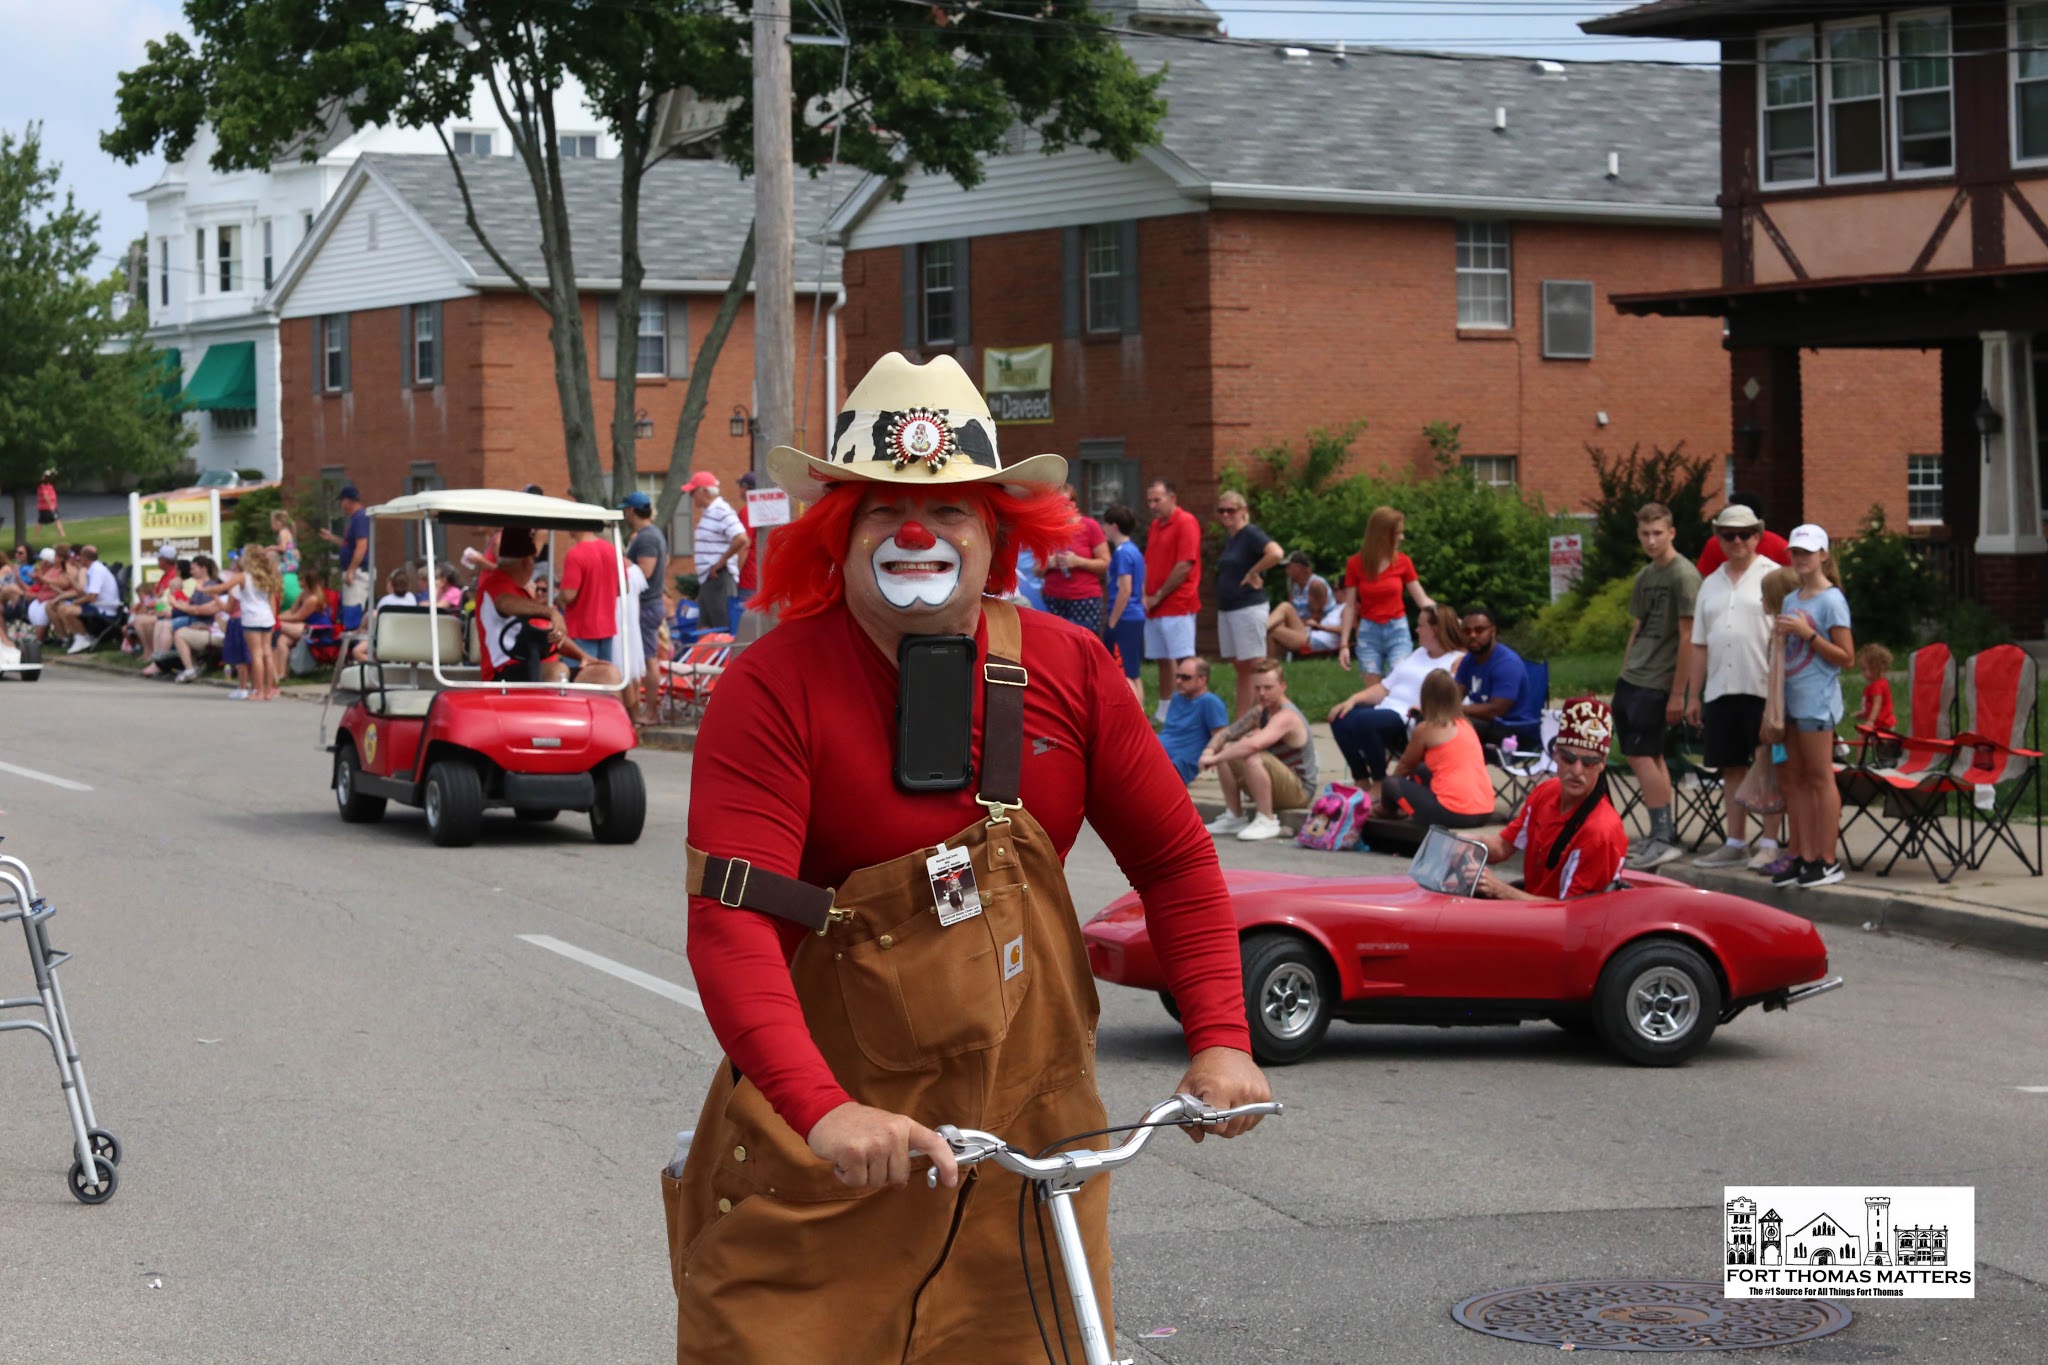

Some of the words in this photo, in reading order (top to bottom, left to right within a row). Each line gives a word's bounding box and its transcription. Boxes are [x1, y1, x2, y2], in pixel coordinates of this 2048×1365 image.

[1002, 392, 1050, 419] Daveed
[143, 512, 206, 528] COURTYARD
[1568, 737, 1598, 749] PRIEST
